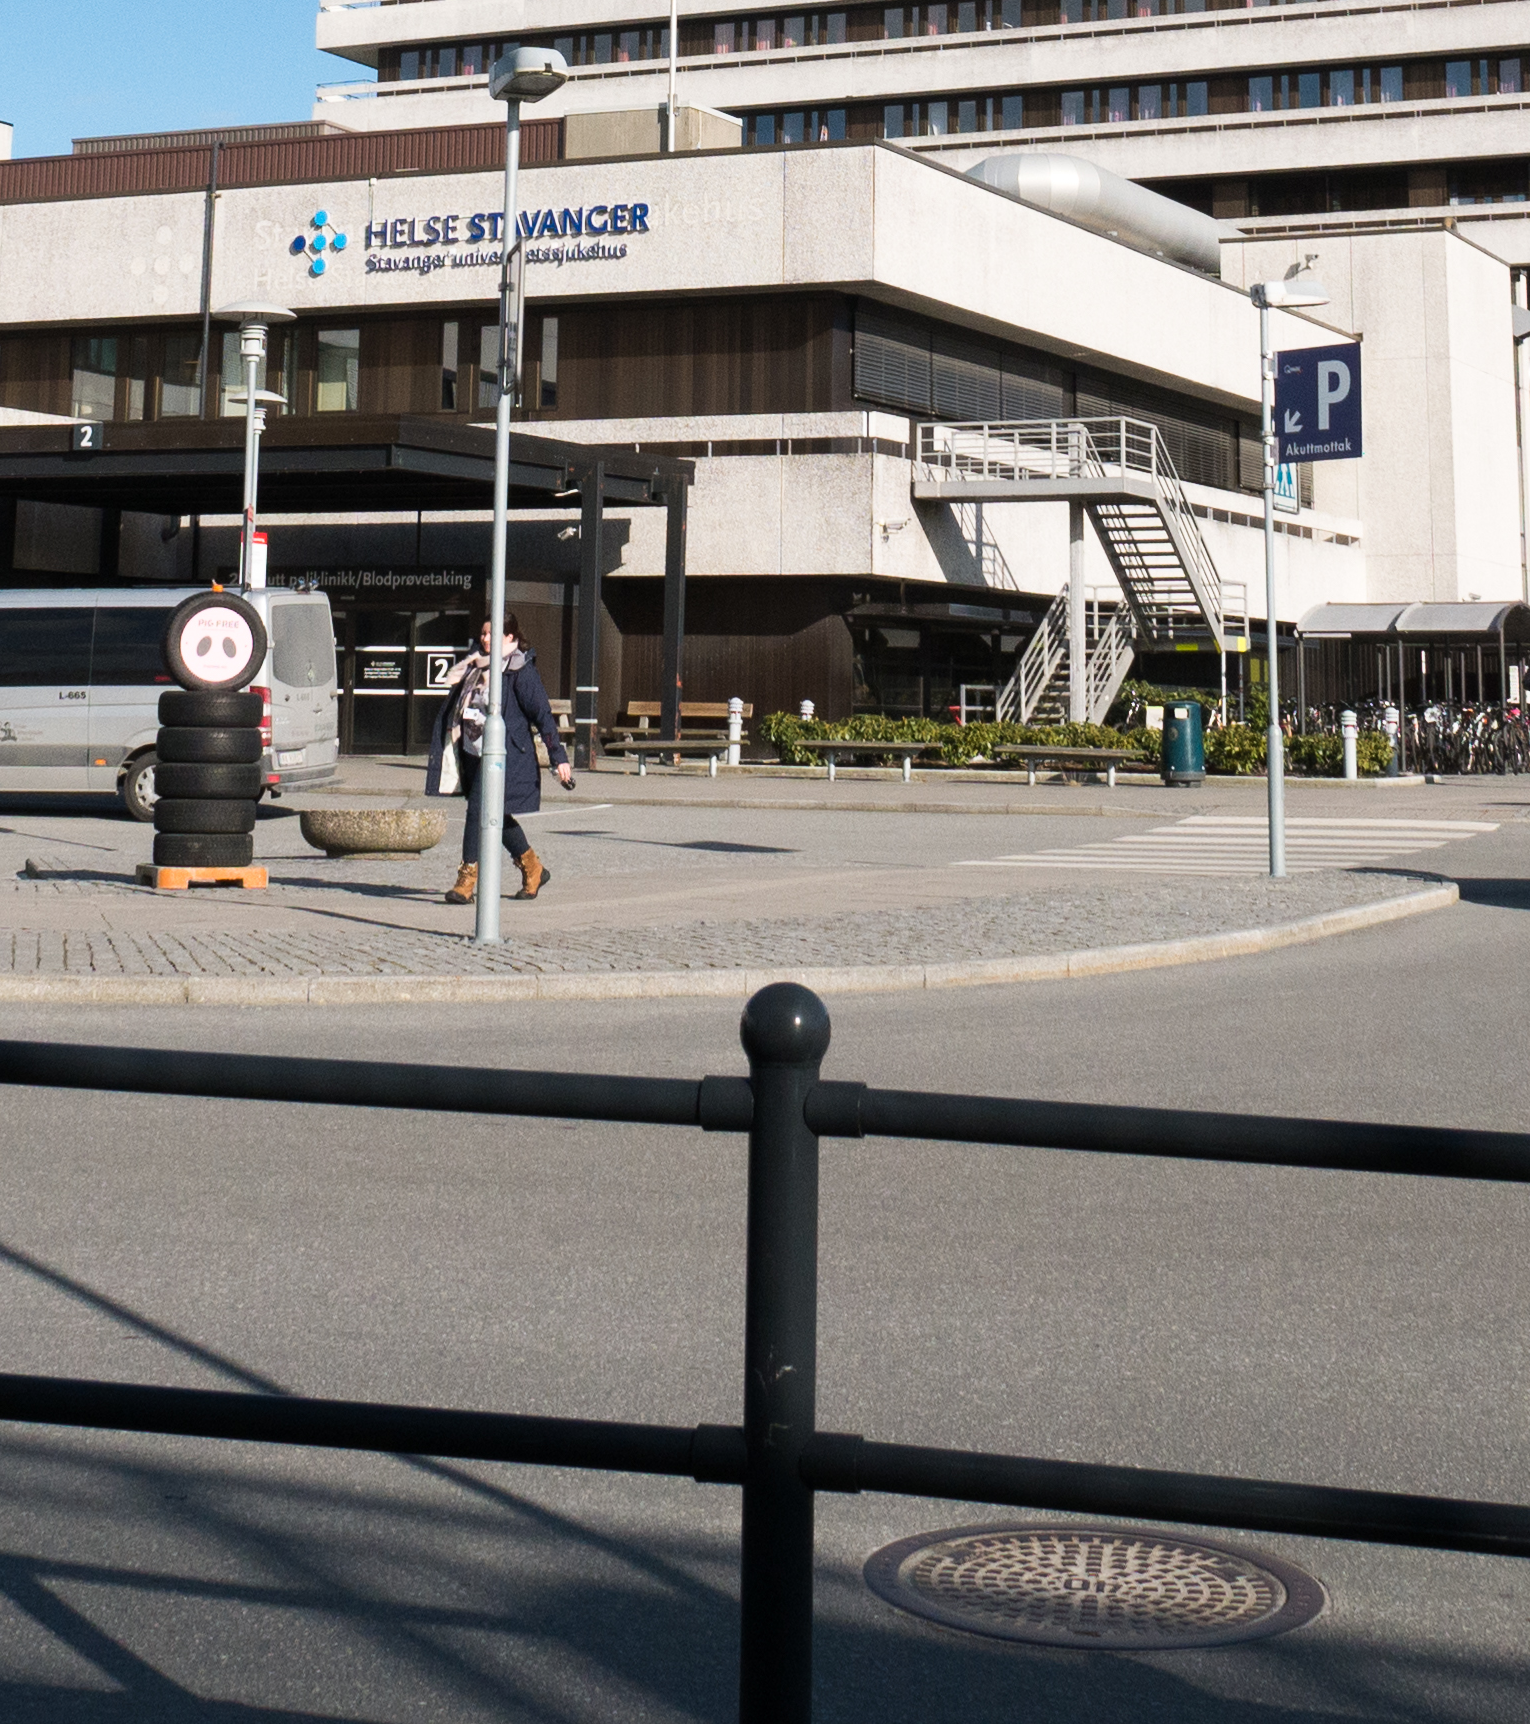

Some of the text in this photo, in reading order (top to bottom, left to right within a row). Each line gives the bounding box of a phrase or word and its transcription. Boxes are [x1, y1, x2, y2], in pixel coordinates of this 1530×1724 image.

[368, 214, 460, 247] HELSE
[368, 250, 446, 274] Stavanger
[452, 239, 628, 267] univeetssjukehus
[1317, 359, 1351, 431] P
[80, 425, 93, 448] 2
[1285, 437, 1353, 457] Akuttmottak
[289, 569, 473, 590] poliklinikk/Blodprøvetaking
[198, 618, 240, 629] PIG FREE
[434, 658, 449, 683] 2
[58, 691, 87, 700] L-665
